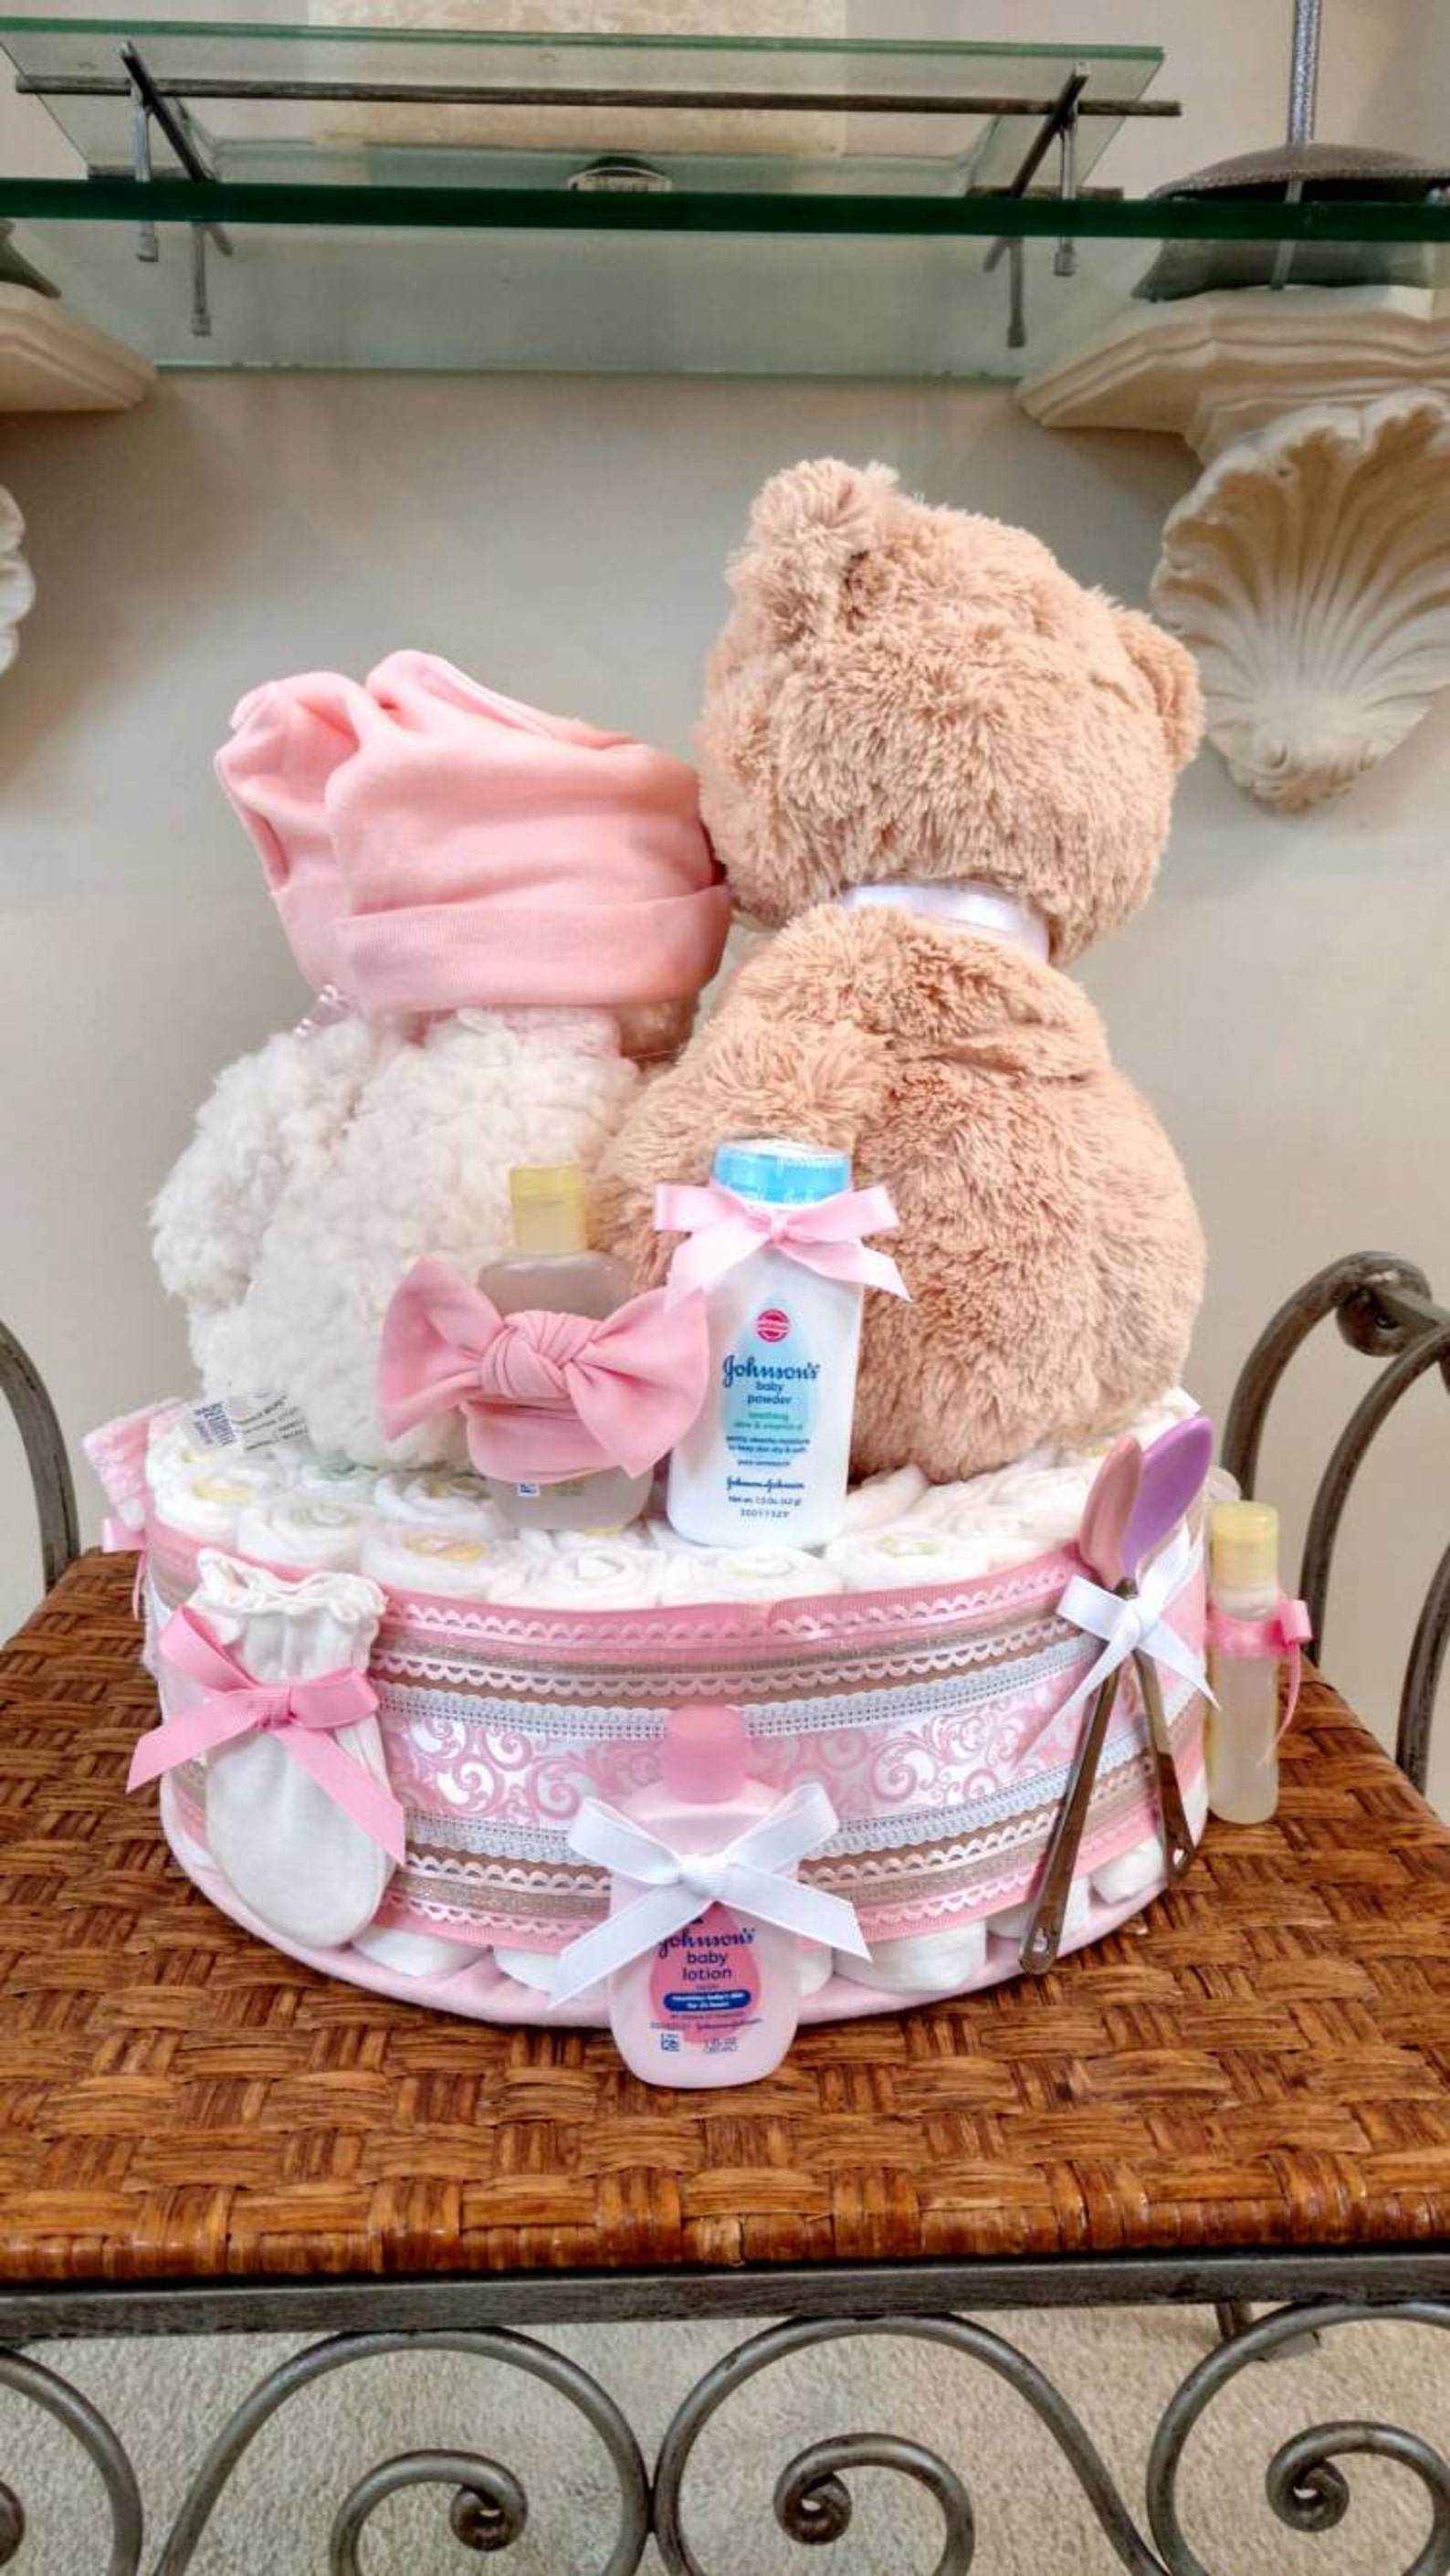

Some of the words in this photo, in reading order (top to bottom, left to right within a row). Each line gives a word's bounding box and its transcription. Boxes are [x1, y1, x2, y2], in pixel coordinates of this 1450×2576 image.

[722, 1354, 819, 1388] Johnson's
[755, 1381, 783, 1394] baby
[747, 1393, 793, 1404] powder
[686, 1950, 729, 1966] baby
[682, 1967, 732, 1981] lotion
